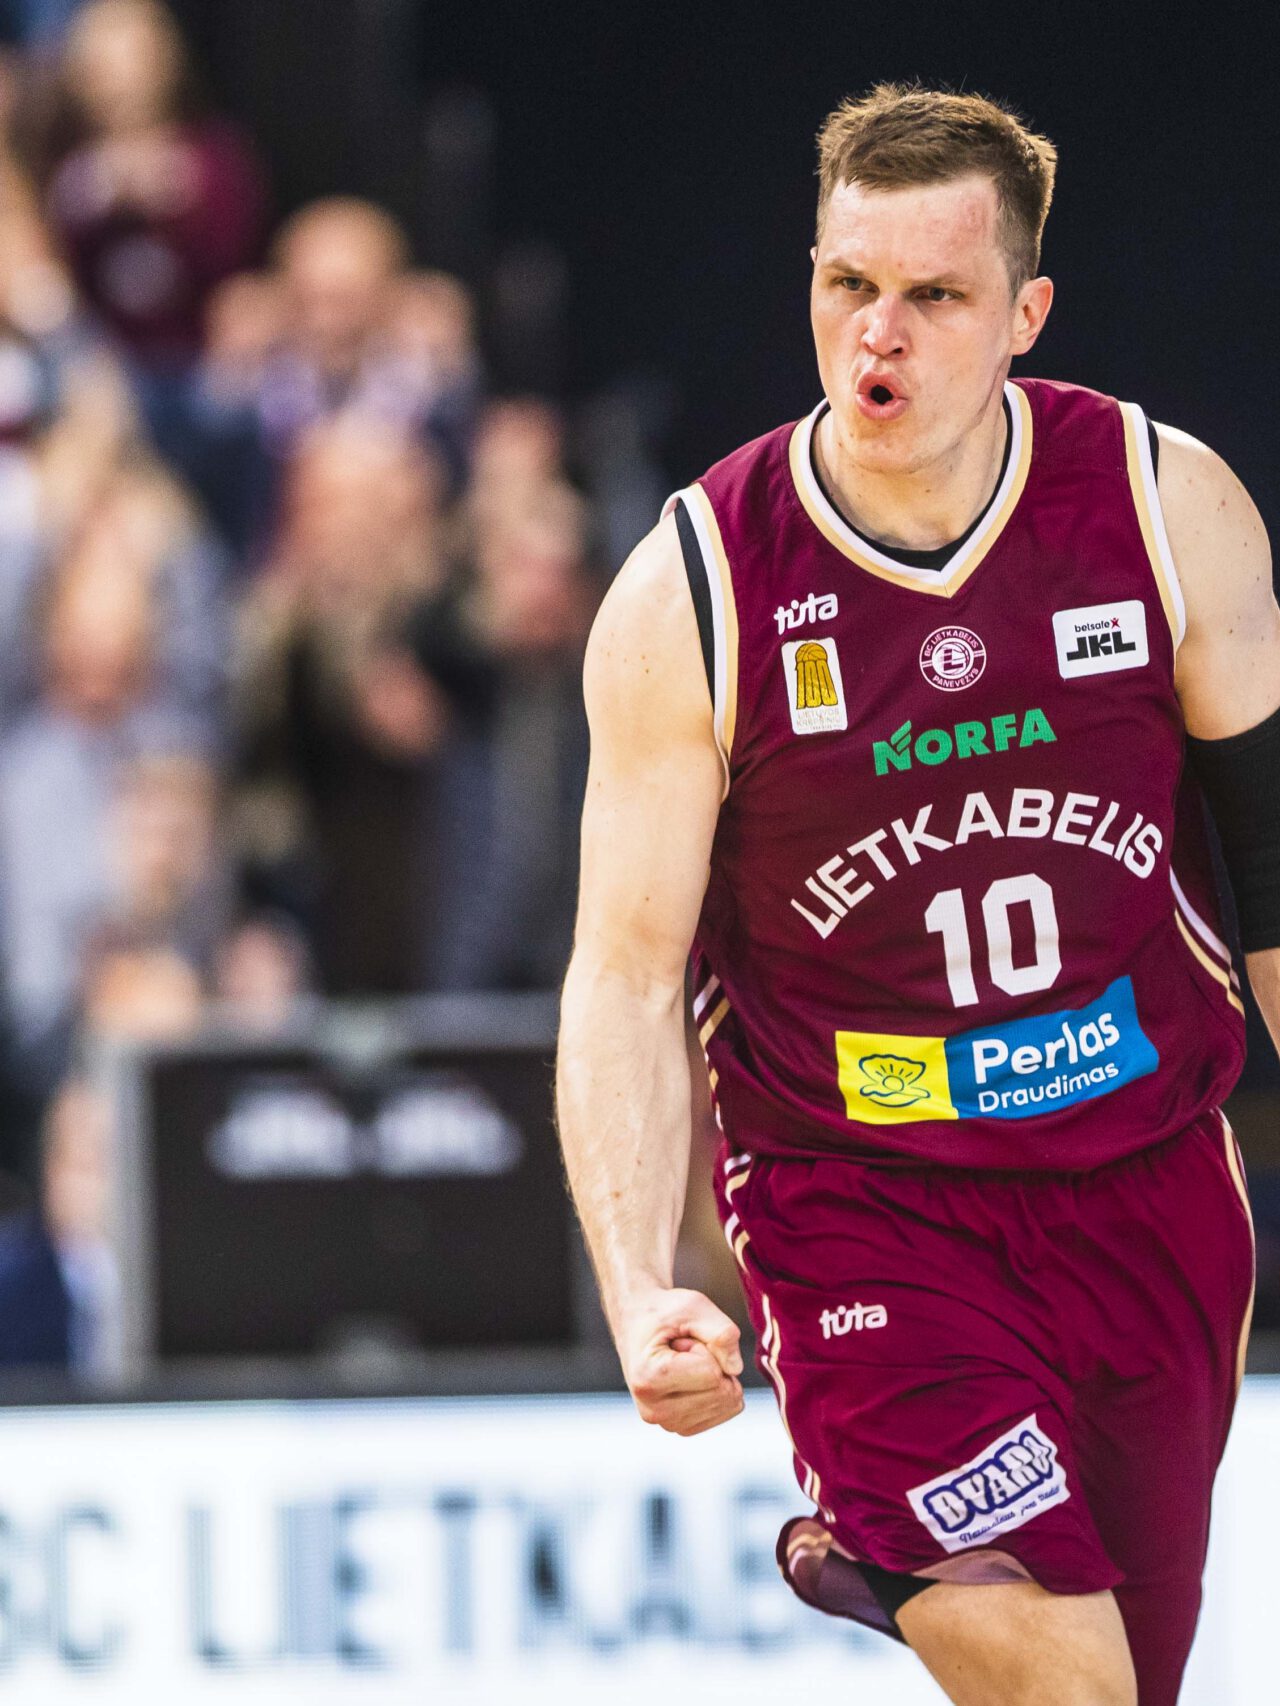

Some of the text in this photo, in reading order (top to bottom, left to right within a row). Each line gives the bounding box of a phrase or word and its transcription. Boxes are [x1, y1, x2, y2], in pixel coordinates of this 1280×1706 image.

[931, 629, 979, 649] LIETKABELIS
[1066, 631, 1136, 661] JKL
[1074, 620, 1110, 632] betsafe
[873, 707, 1057, 776] NORFA
[790, 787, 1163, 939] LIETKABELIS
[924, 873, 1062, 1008] 10
[971, 1011, 1121, 1084] Perlas
[978, 1061, 1119, 1113] Draudimas
